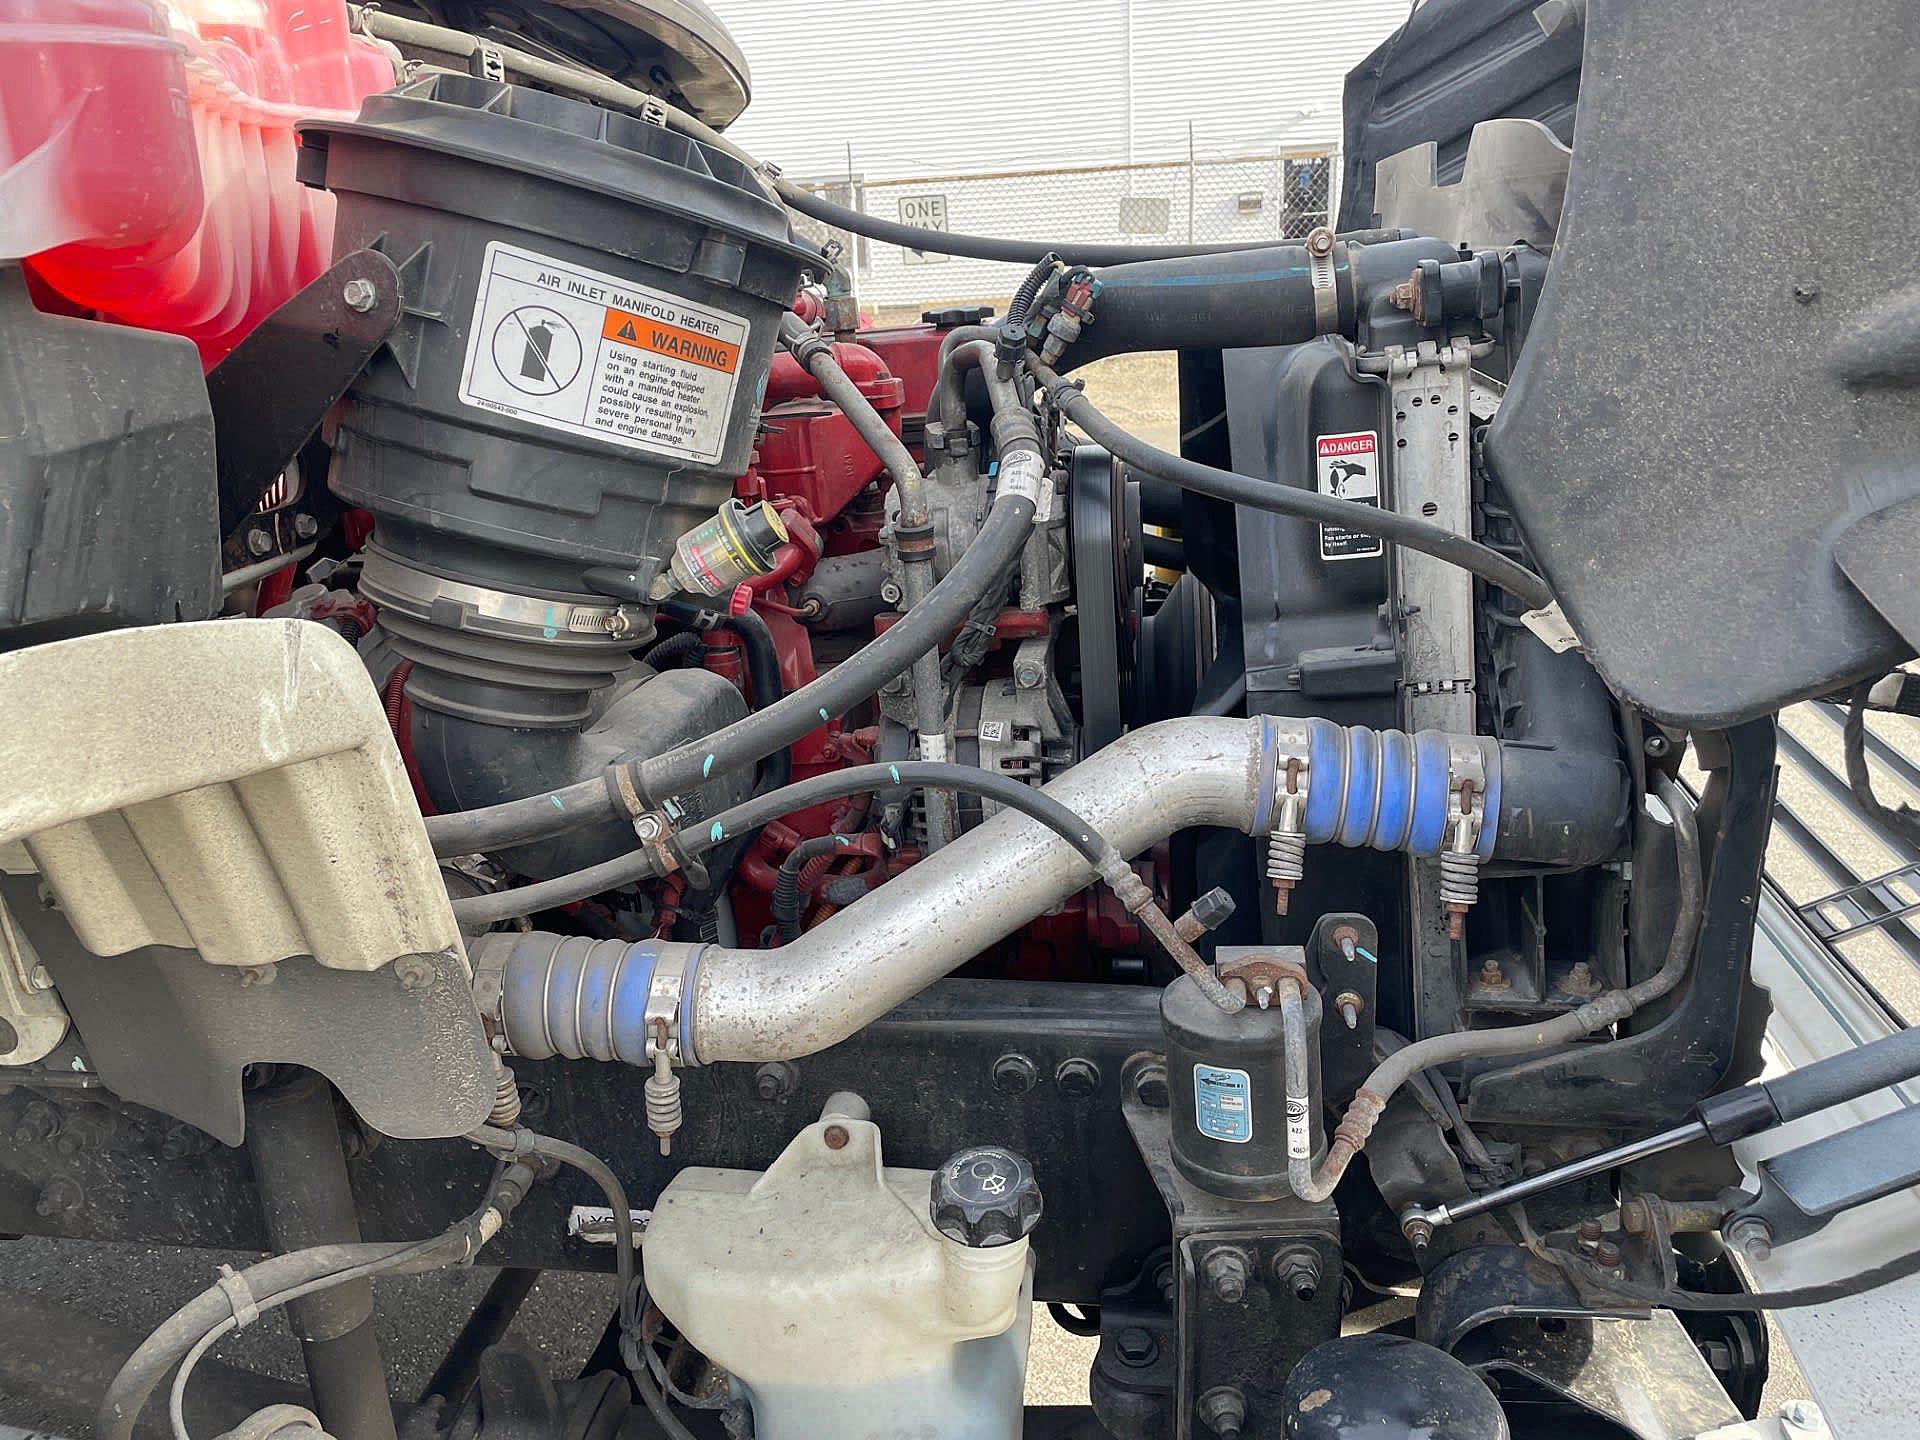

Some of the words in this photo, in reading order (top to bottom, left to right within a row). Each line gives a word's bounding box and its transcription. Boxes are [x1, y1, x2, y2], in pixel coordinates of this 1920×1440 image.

[905, 201, 942, 218] ONE
[536, 272, 561, 288] AIR
[567, 280, 607, 300] INLET
[612, 294, 675, 322] MANIFOLD
[680, 314, 720, 335] HEATER
[651, 330, 728, 367] WARNING
[606, 361, 620, 371] on
[623, 367, 635, 375] an
[639, 370, 668, 385] engine
[671, 380, 705, 394] equipped
[609, 349, 638, 366] Using
[642, 360, 676, 377] starting
[680, 369, 698, 381] fluid
[602, 384, 628, 397] could
[631, 392, 658, 405] cause
[661, 399, 671, 407] an
[604, 373, 625, 385] with
[638, 382, 675, 397] manifold
[677, 391, 701, 404] heater
[597, 406, 630, 420] severe
[634, 415, 672, 430] personal
[675, 423, 697, 438] injury
[600, 395, 640, 412] possibly
[645, 407, 682, 423] resulting
[685, 415, 693, 424] in
[594, 416, 614, 428] and
[617, 422, 648, 436] engine
[651, 430, 684, 445] damage.
[1329, 440, 1373, 453] DANGER
